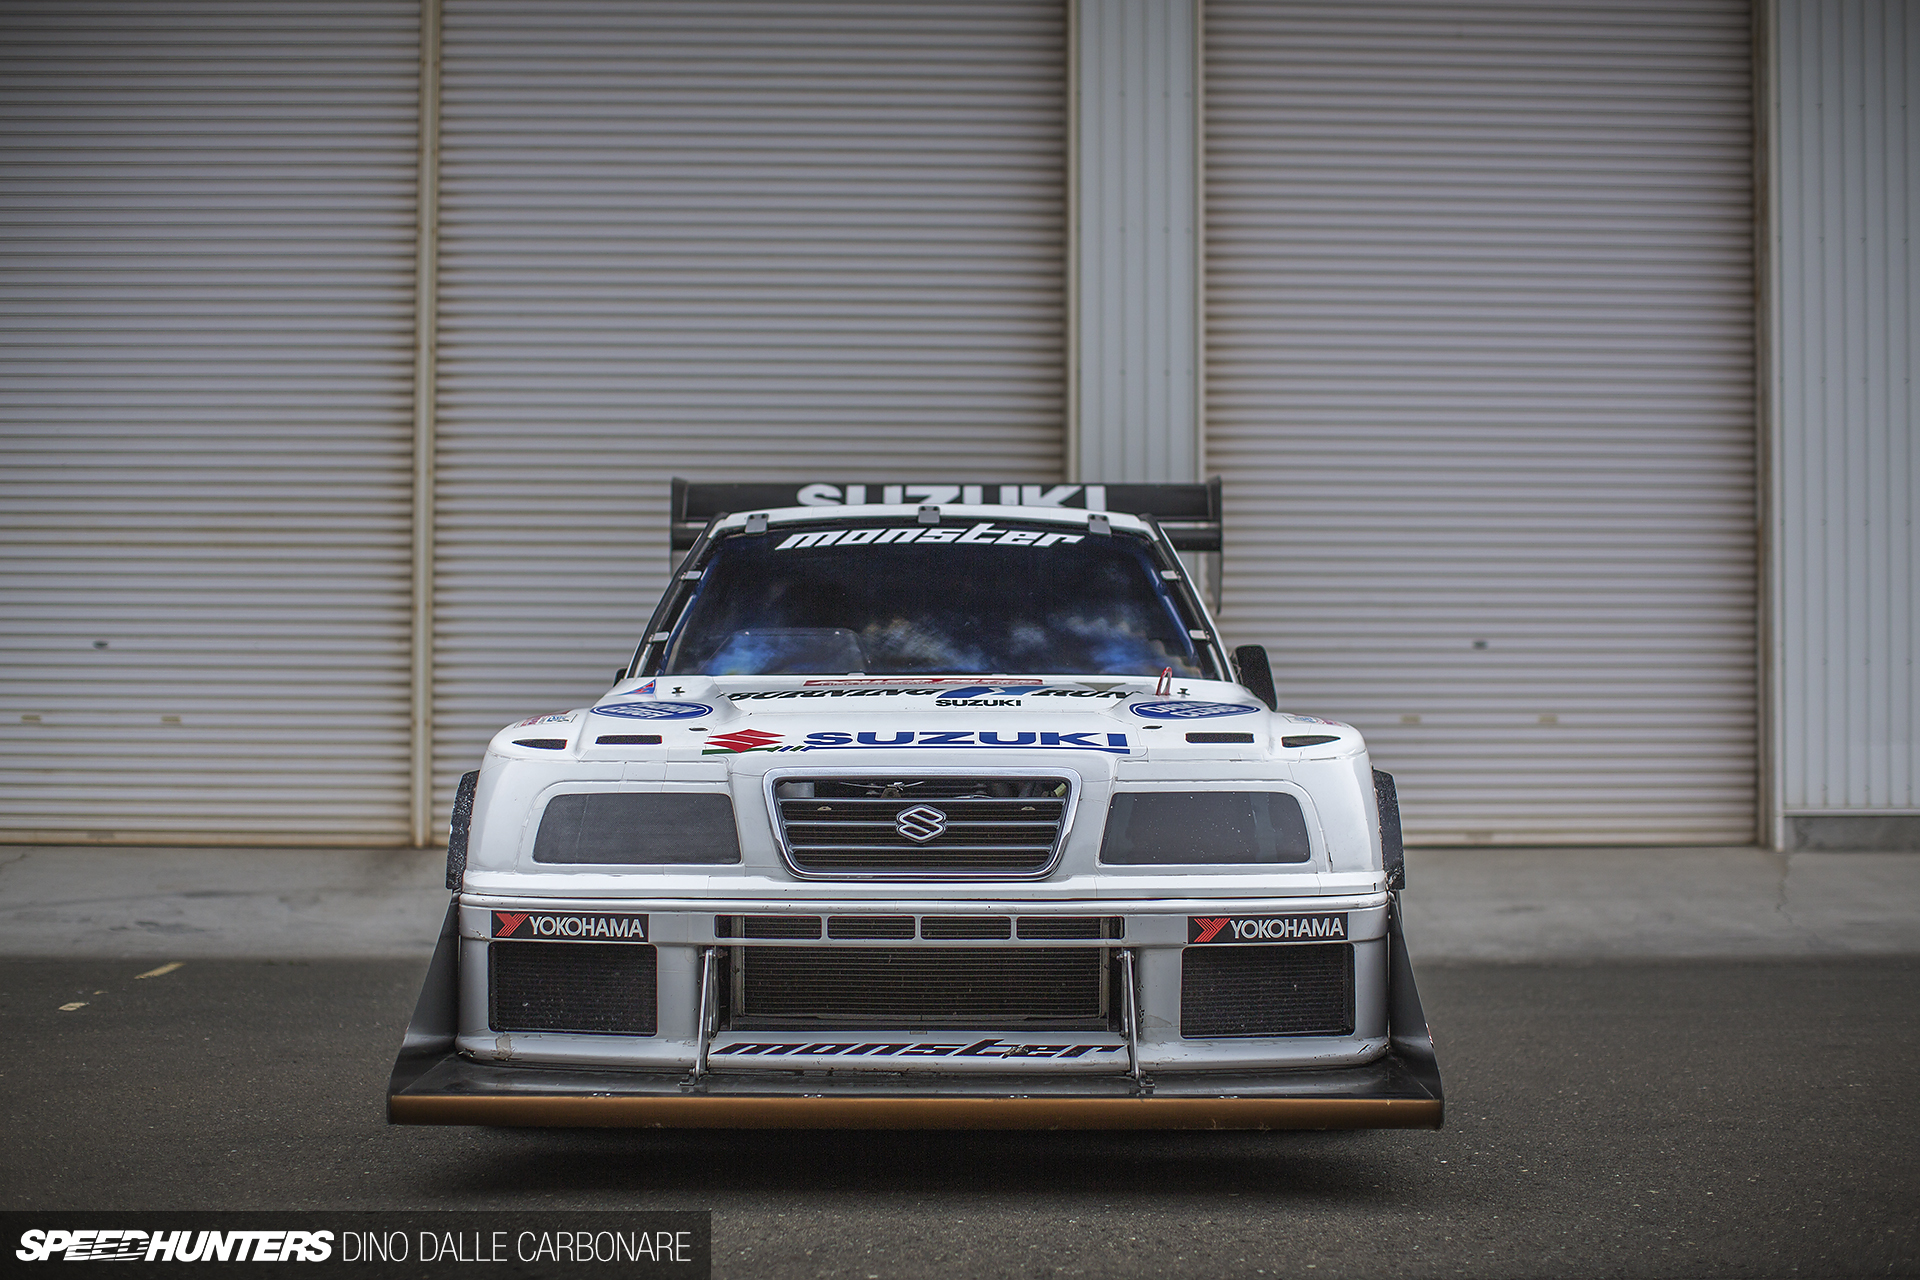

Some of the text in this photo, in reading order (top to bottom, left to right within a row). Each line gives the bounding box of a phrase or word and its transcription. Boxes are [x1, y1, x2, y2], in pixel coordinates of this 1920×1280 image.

[776, 523, 1085, 549] monster
[935, 699, 1021, 707] SUZUKI
[803, 731, 1128, 747] SUZUKI
[529, 917, 644, 938] YOKOHAMA
[1230, 917, 1345, 938] YOKOHAMA
[711, 1038, 1126, 1058] monster
